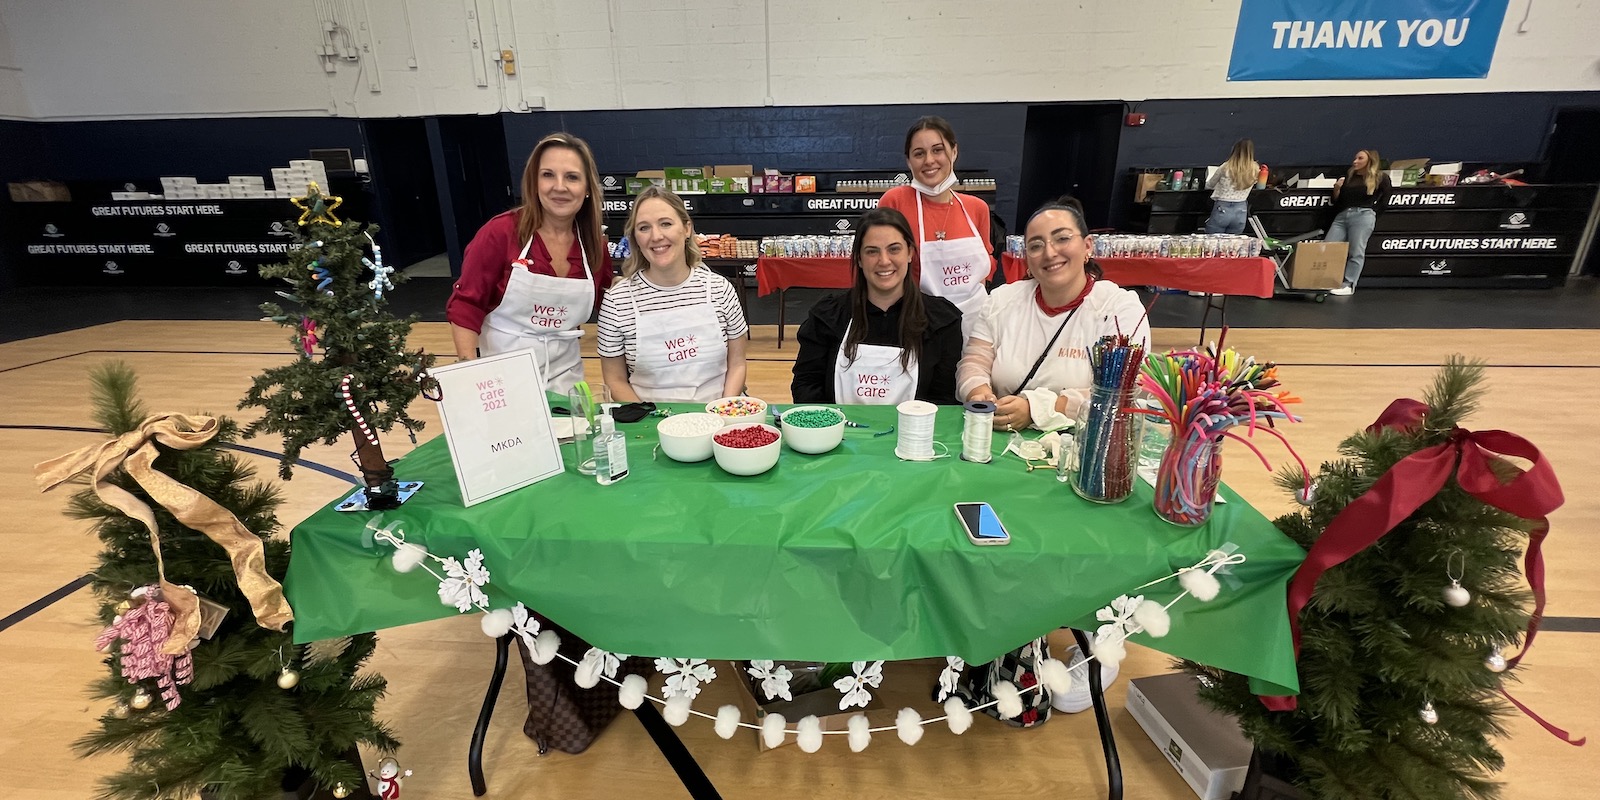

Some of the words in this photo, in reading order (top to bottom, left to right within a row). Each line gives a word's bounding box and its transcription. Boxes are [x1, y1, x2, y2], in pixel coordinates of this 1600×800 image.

[1272, 20, 1387, 49] THANK
[1397, 18, 1470, 48] YOU
[808, 199, 843, 210] GREAT
[1280, 196, 1317, 207] GREAT
[1388, 195, 1419, 205] TART
[1417, 194, 1456, 205] HERE.
[92, 206, 120, 216] GREAT
[122, 206, 165, 215] FUTURES
[165, 205, 194, 215] START
[195, 205, 223, 214] HERE.
[28, 245, 55, 254] GREAT
[56, 245, 98, 253] FUTURES
[98, 245, 126, 253] START
[127, 244, 154, 253] HERE.
[185, 244, 213, 253] GREAT
[214, 244, 258, 253] FUTURES
[259, 244, 287, 253] START
[1382, 239, 1422, 250] GREAT
[1422, 239, 1479, 249] FUTURES
[1480, 238, 1521, 249] START
[1521, 238, 1557, 249] HERE.
[942, 265, 961, 275] we
[534, 304, 555, 316] we
[664, 337, 686, 350] we
[476, 379, 495, 391] we
[858, 373, 879, 385] we
[479, 387, 505, 402] care
[482, 398, 508, 412] 2021
[491, 436, 522, 453] MKDA
